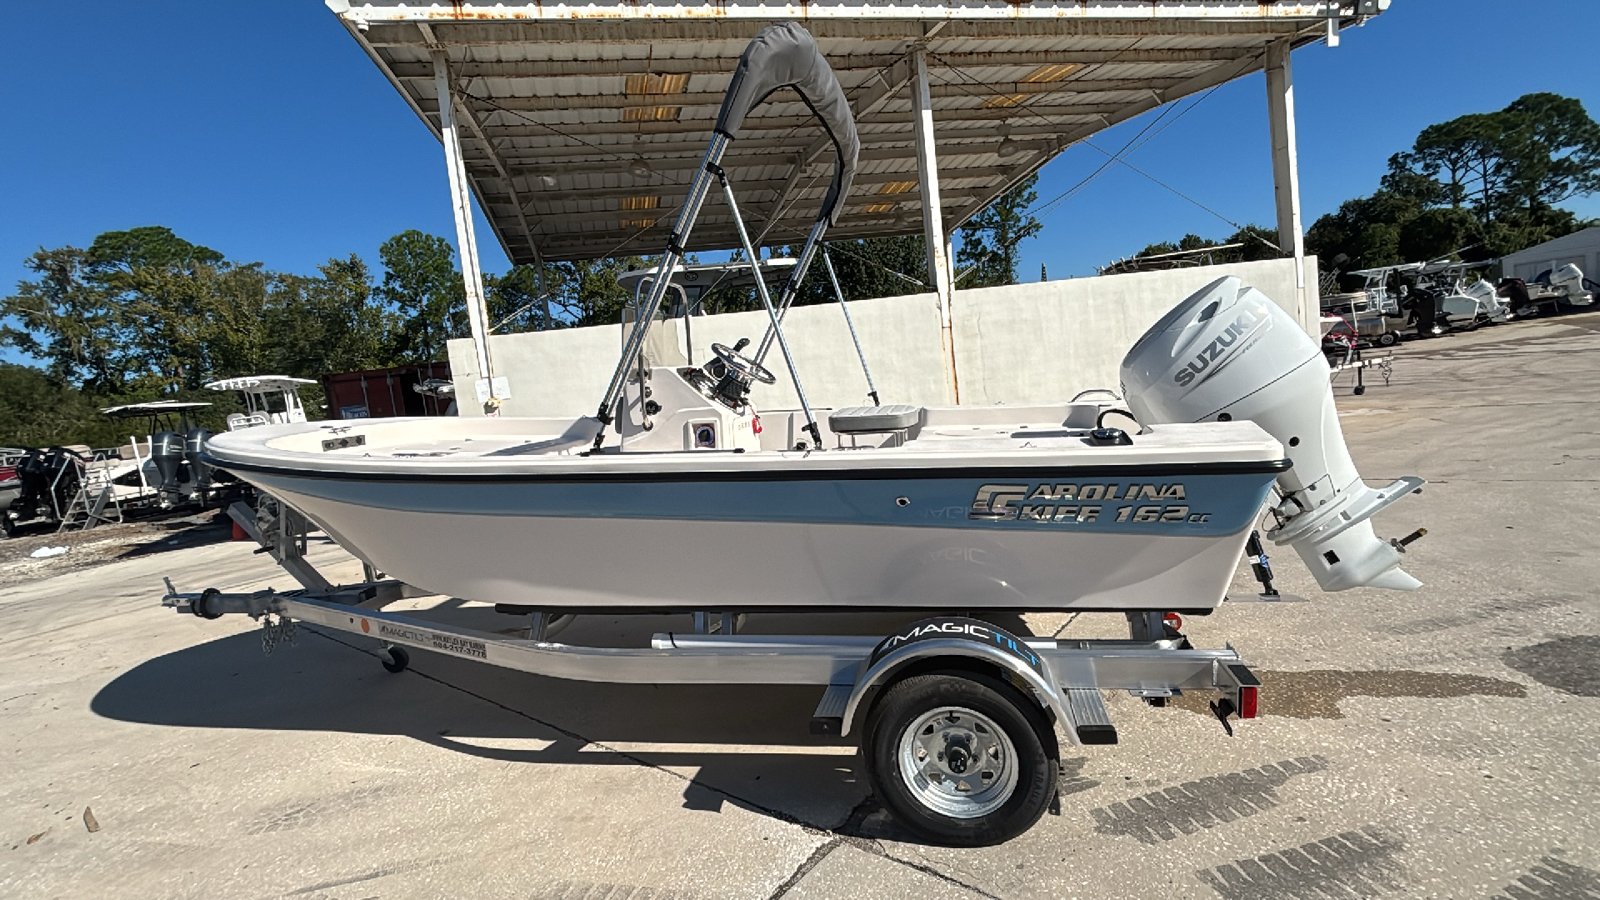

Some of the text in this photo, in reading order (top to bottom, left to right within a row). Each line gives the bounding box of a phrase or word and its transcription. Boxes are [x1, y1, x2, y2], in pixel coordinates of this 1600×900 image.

[1174, 310, 1257, 387] SUZUKI
[969, 493, 1102, 523] SKIFF
[971, 484, 1186, 513] CAROLINA
[893, 622, 1041, 666] MAGICTILT
